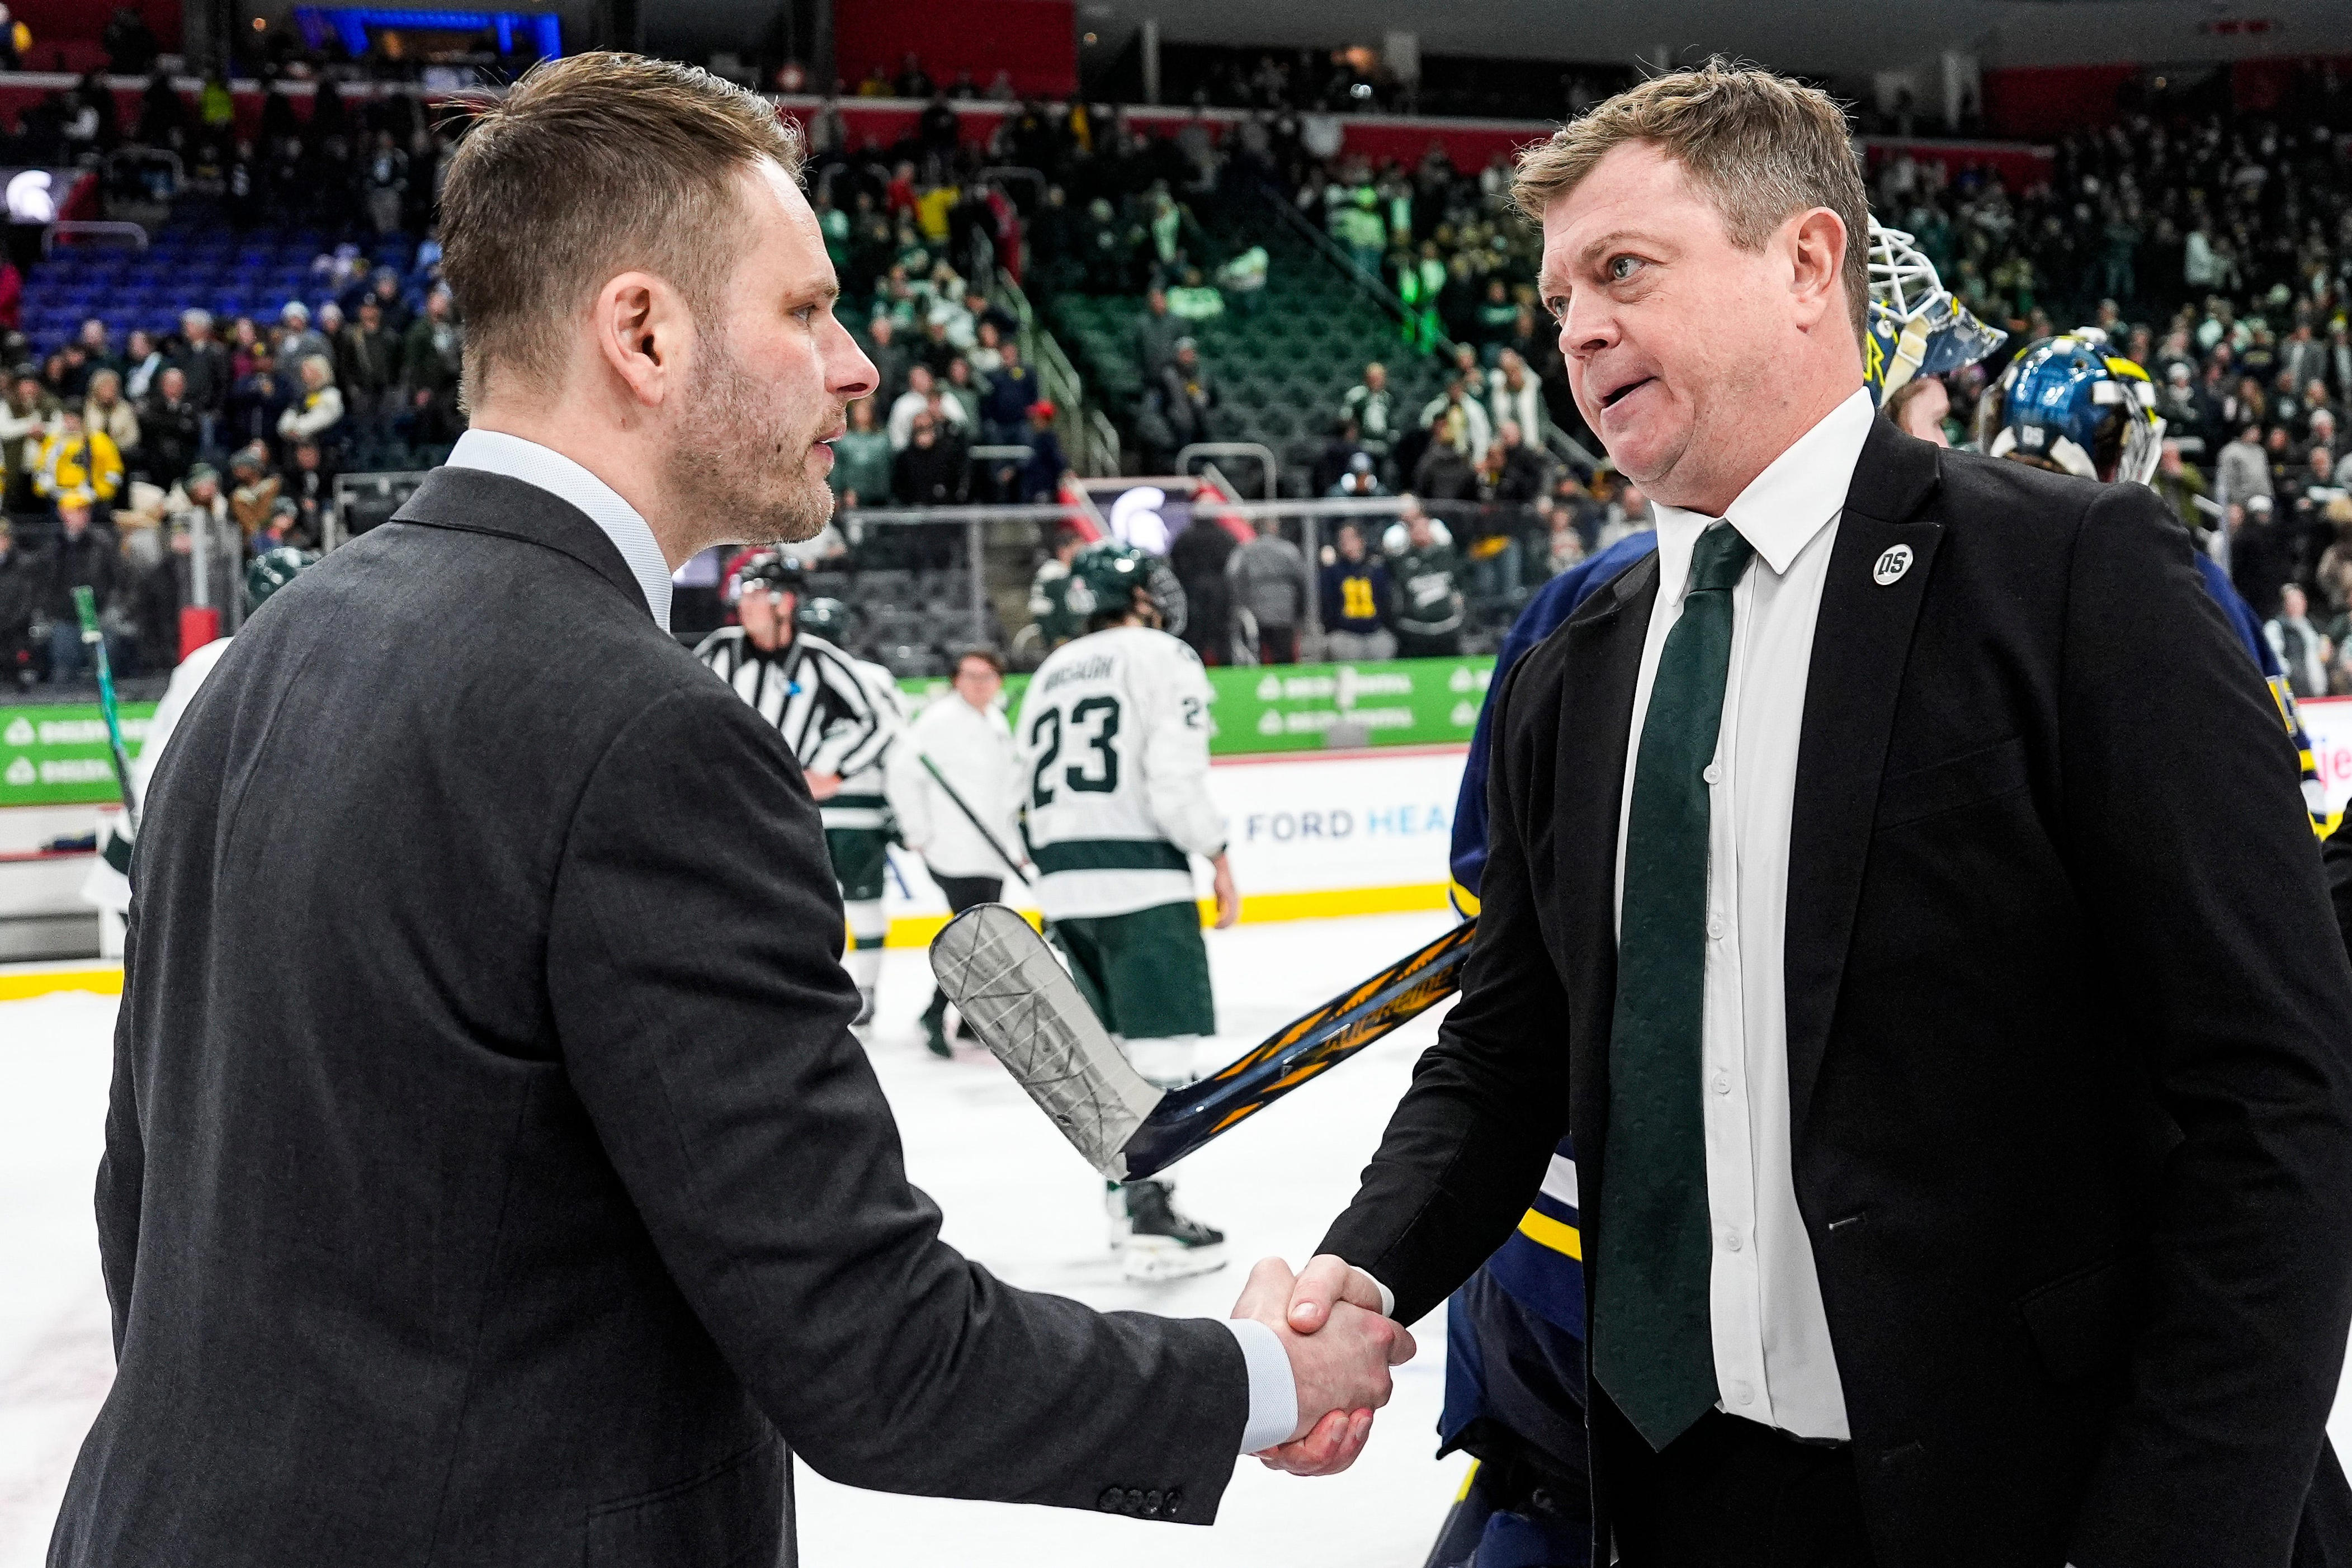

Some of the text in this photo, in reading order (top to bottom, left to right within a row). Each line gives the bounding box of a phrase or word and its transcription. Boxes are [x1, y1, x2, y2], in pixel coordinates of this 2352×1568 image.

[1877, 551, 1907, 576] DS
[1031, 695, 1120, 809] 23
[1246, 809, 1354, 842] FORD
